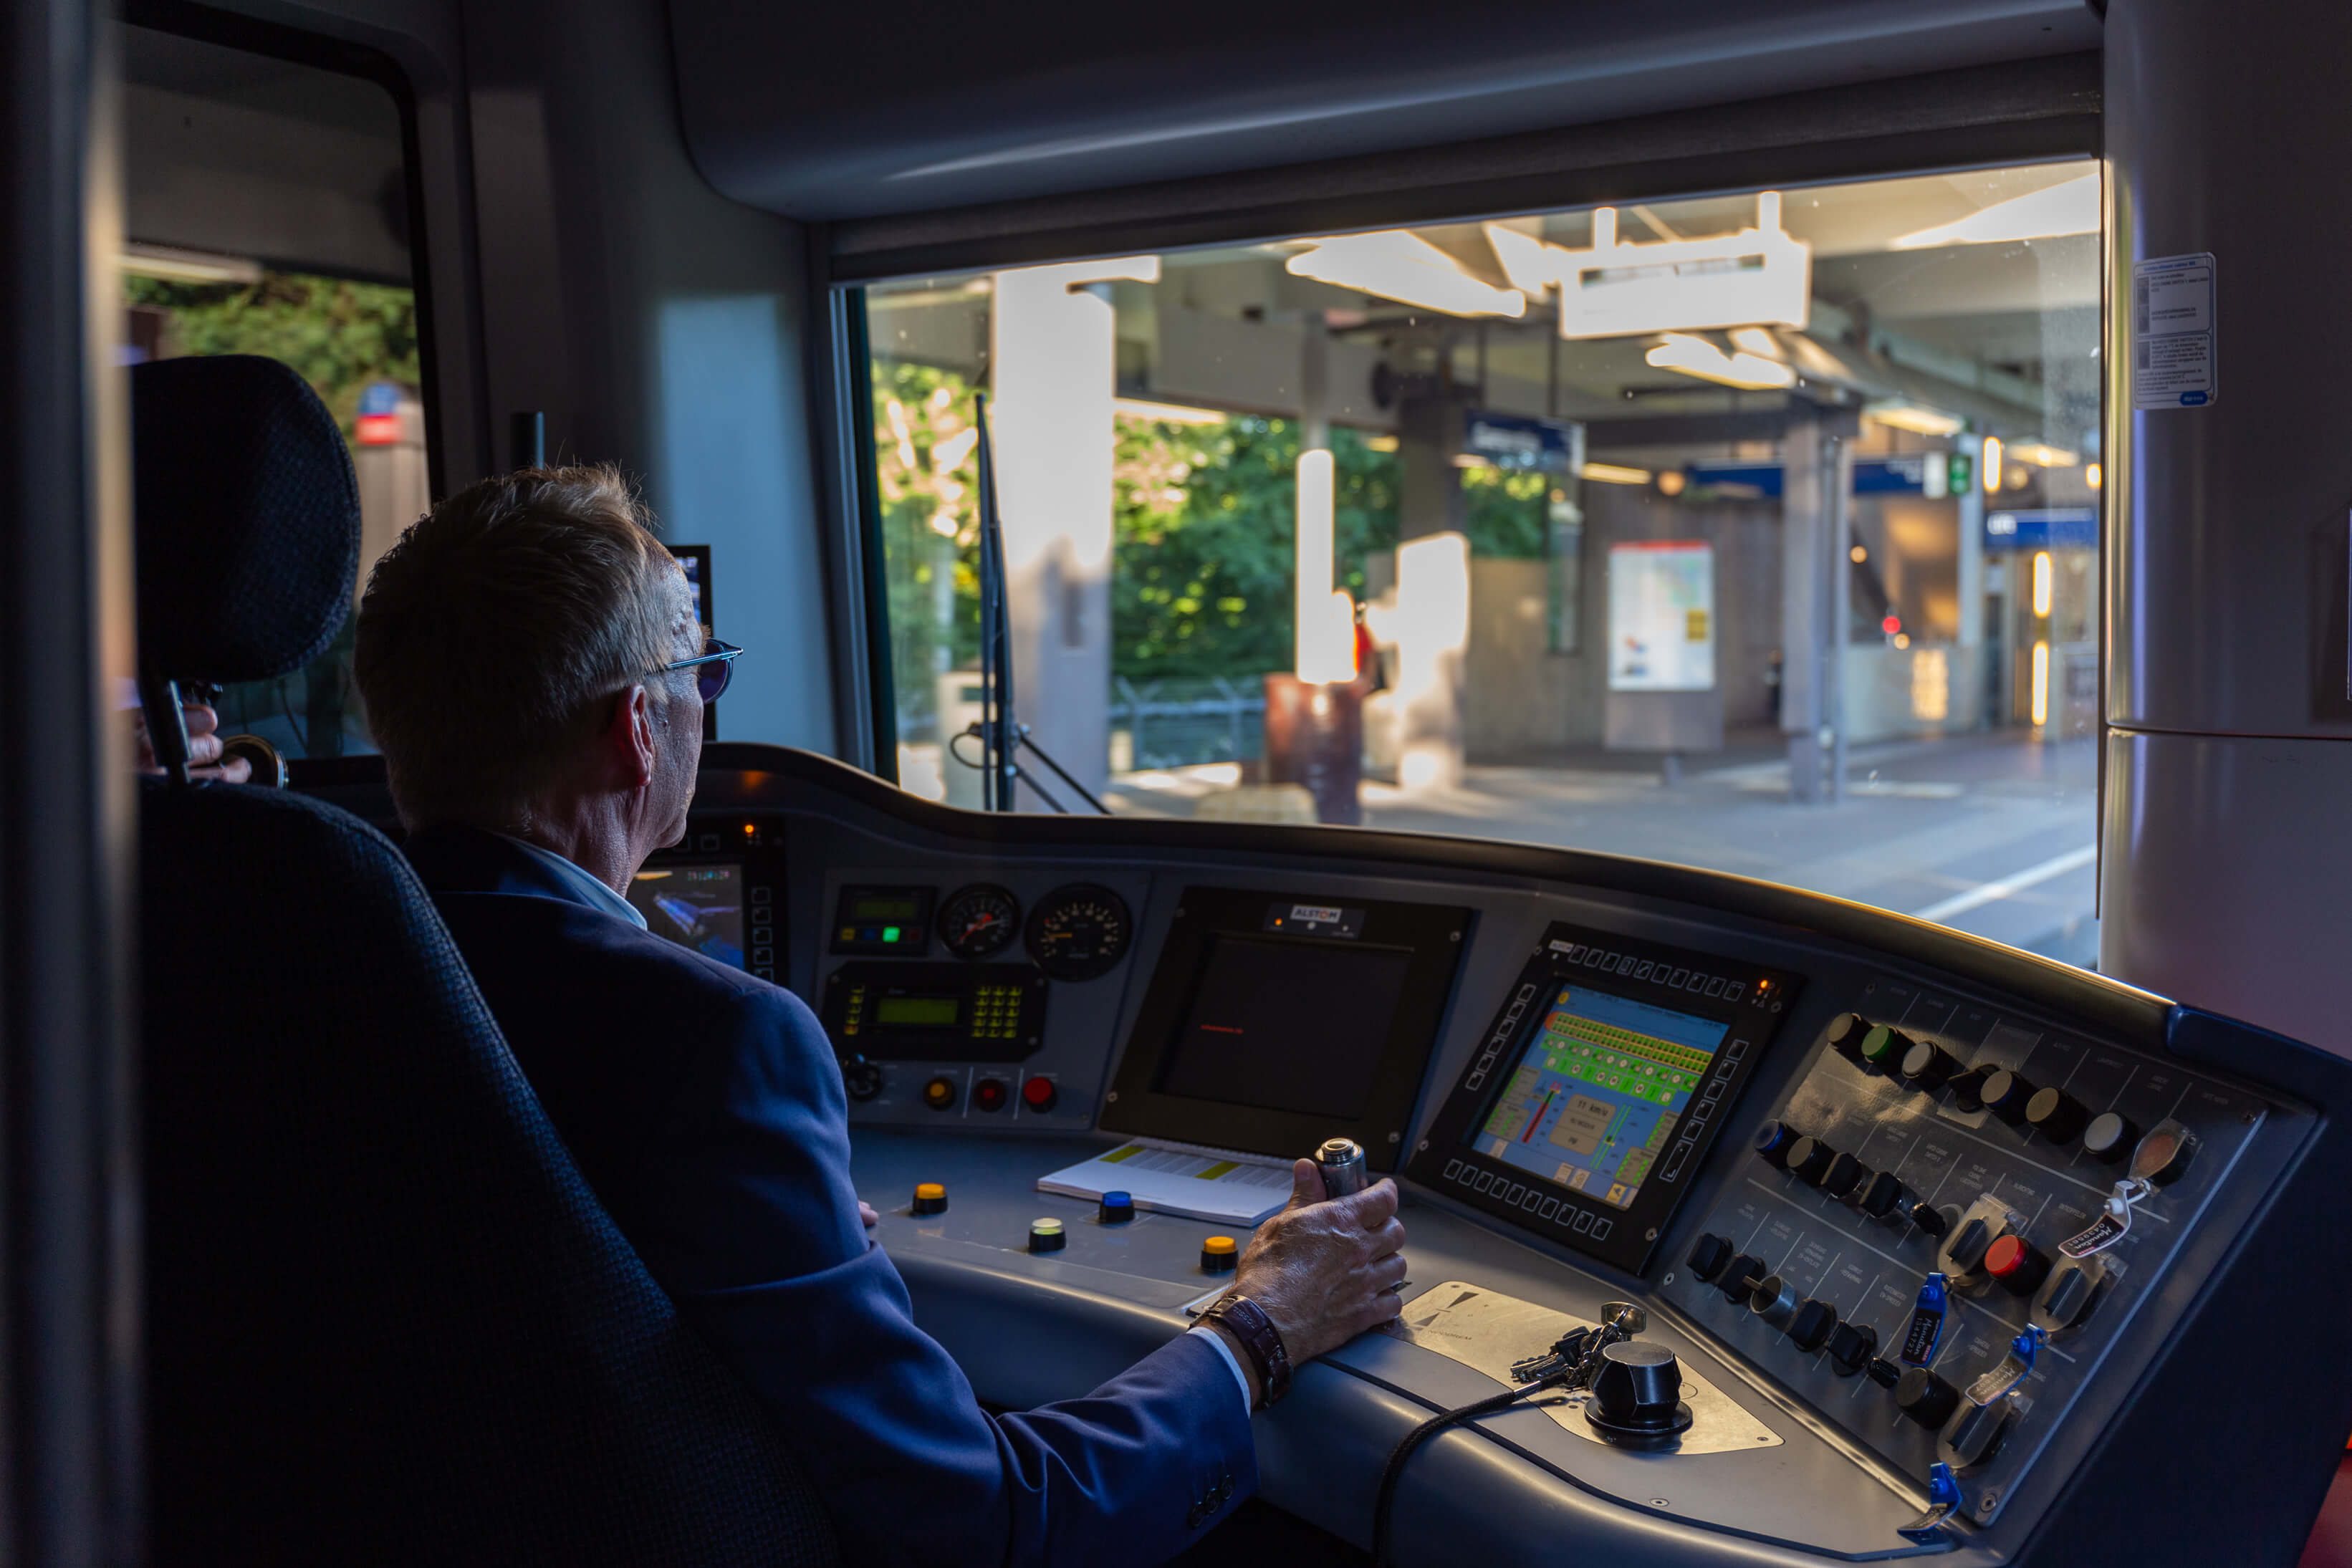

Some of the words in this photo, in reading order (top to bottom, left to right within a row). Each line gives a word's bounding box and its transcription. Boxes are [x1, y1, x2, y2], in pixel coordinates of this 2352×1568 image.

[1295, 908, 1337, 920] ALSTOM
[2075, 1226, 2113, 1249] Manutan
[1914, 1317, 1932, 1355] Manutan
